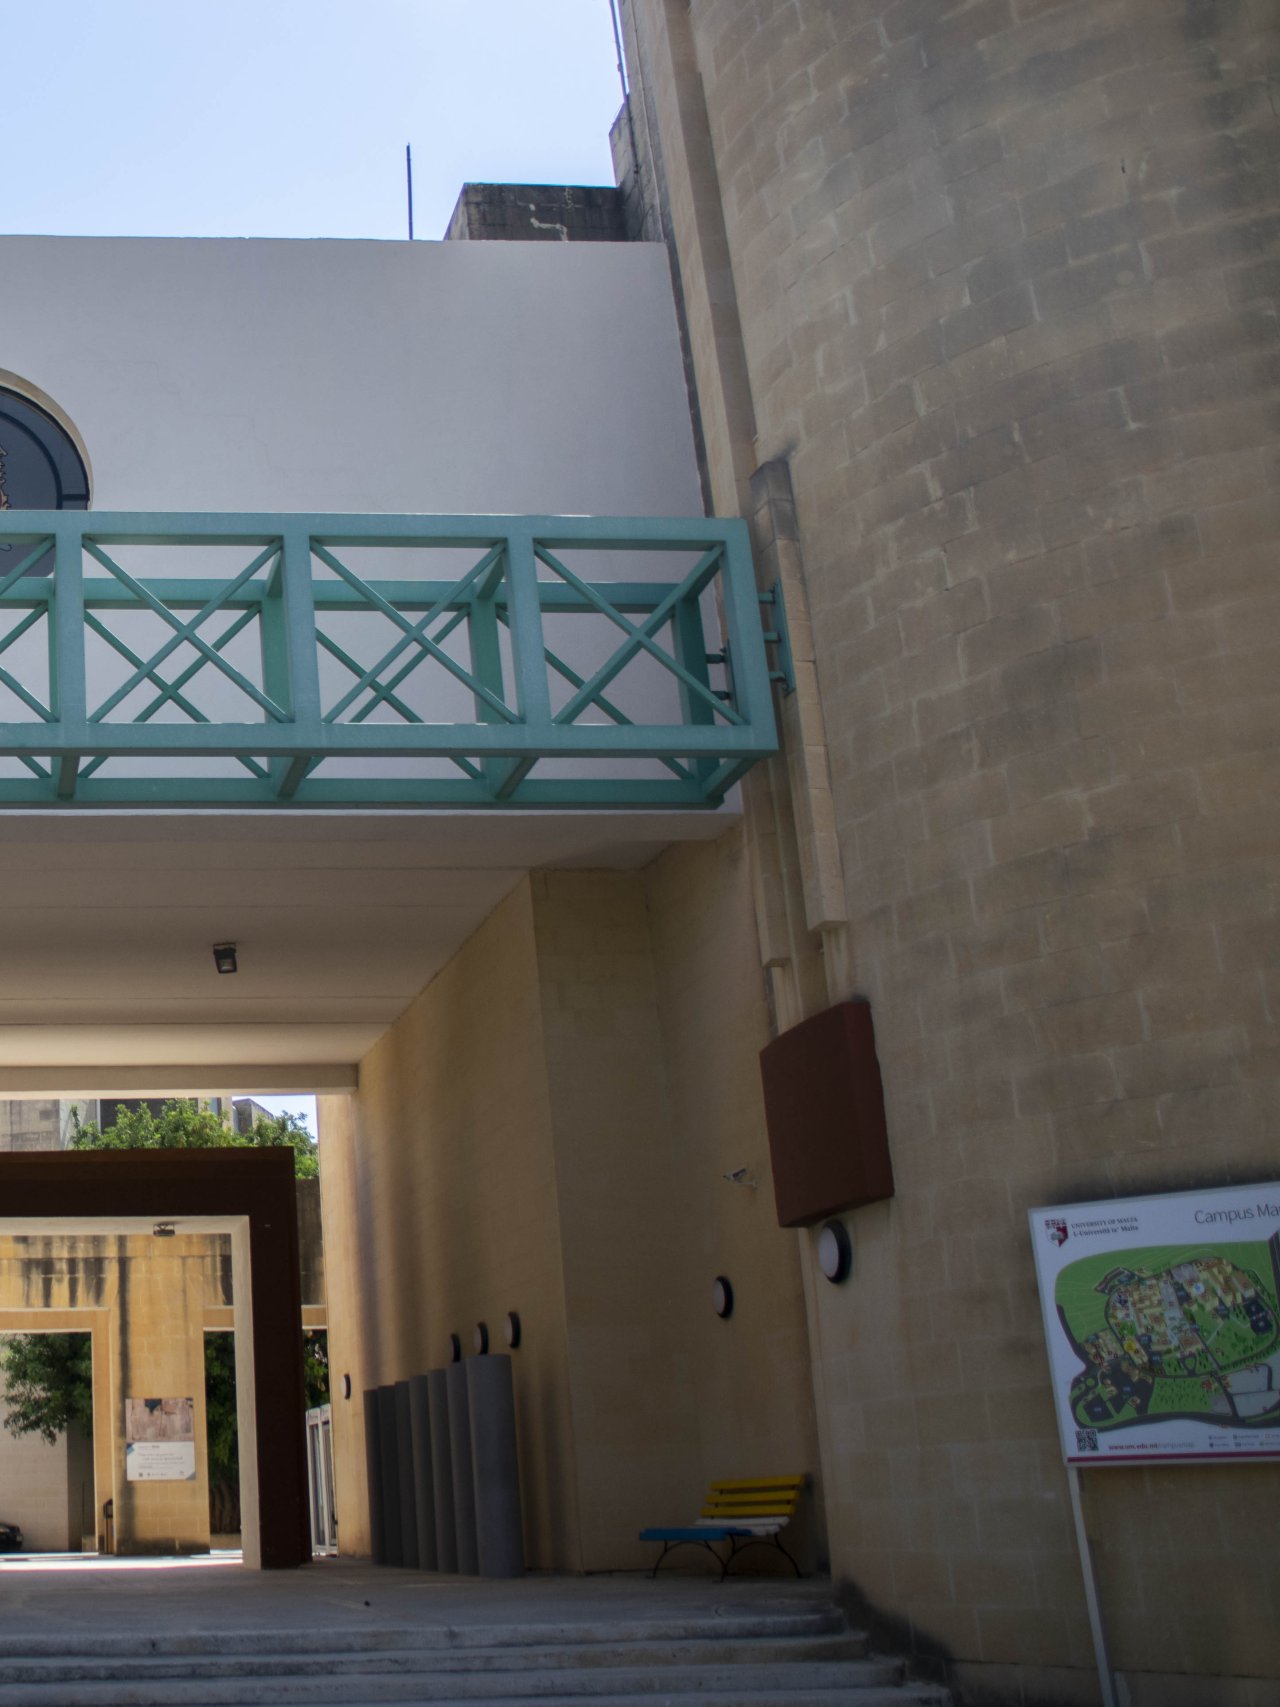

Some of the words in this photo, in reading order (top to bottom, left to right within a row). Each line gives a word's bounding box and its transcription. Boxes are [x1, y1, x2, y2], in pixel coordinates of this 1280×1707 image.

[1071, 1220, 1107, 1230] UNIVERSITY
[1107, 1218, 1116, 1226] OF
[1117, 1216, 1138, 1225] MALTA
[1194, 1208, 1254, 1225] Campus
[1257, 1203, 1280, 1218] Ma
